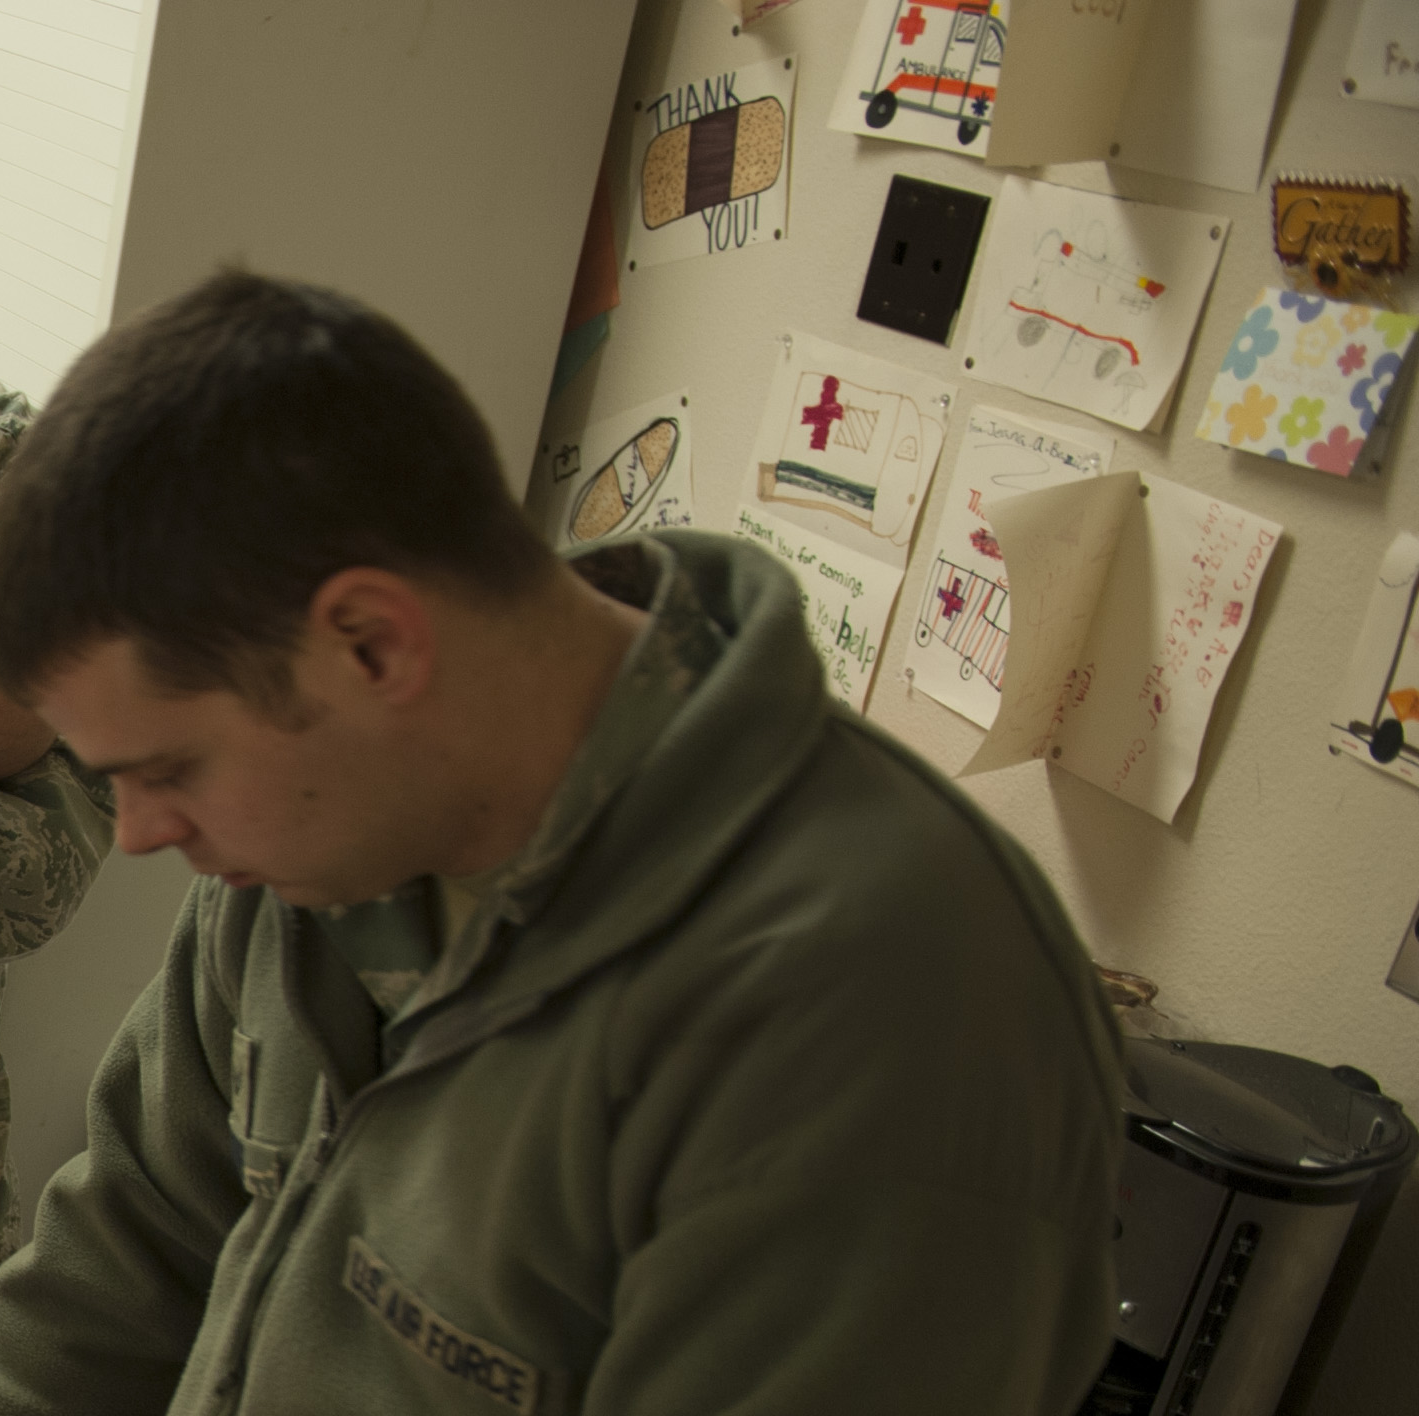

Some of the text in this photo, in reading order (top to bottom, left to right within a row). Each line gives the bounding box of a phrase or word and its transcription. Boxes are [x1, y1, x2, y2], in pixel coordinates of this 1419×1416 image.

[895, 58, 967, 81] AMBULANCE
[647, 71, 742, 134] THANK
[701, 193, 759, 254] YOU!
[426, 1320, 527, 1407] FORCE
